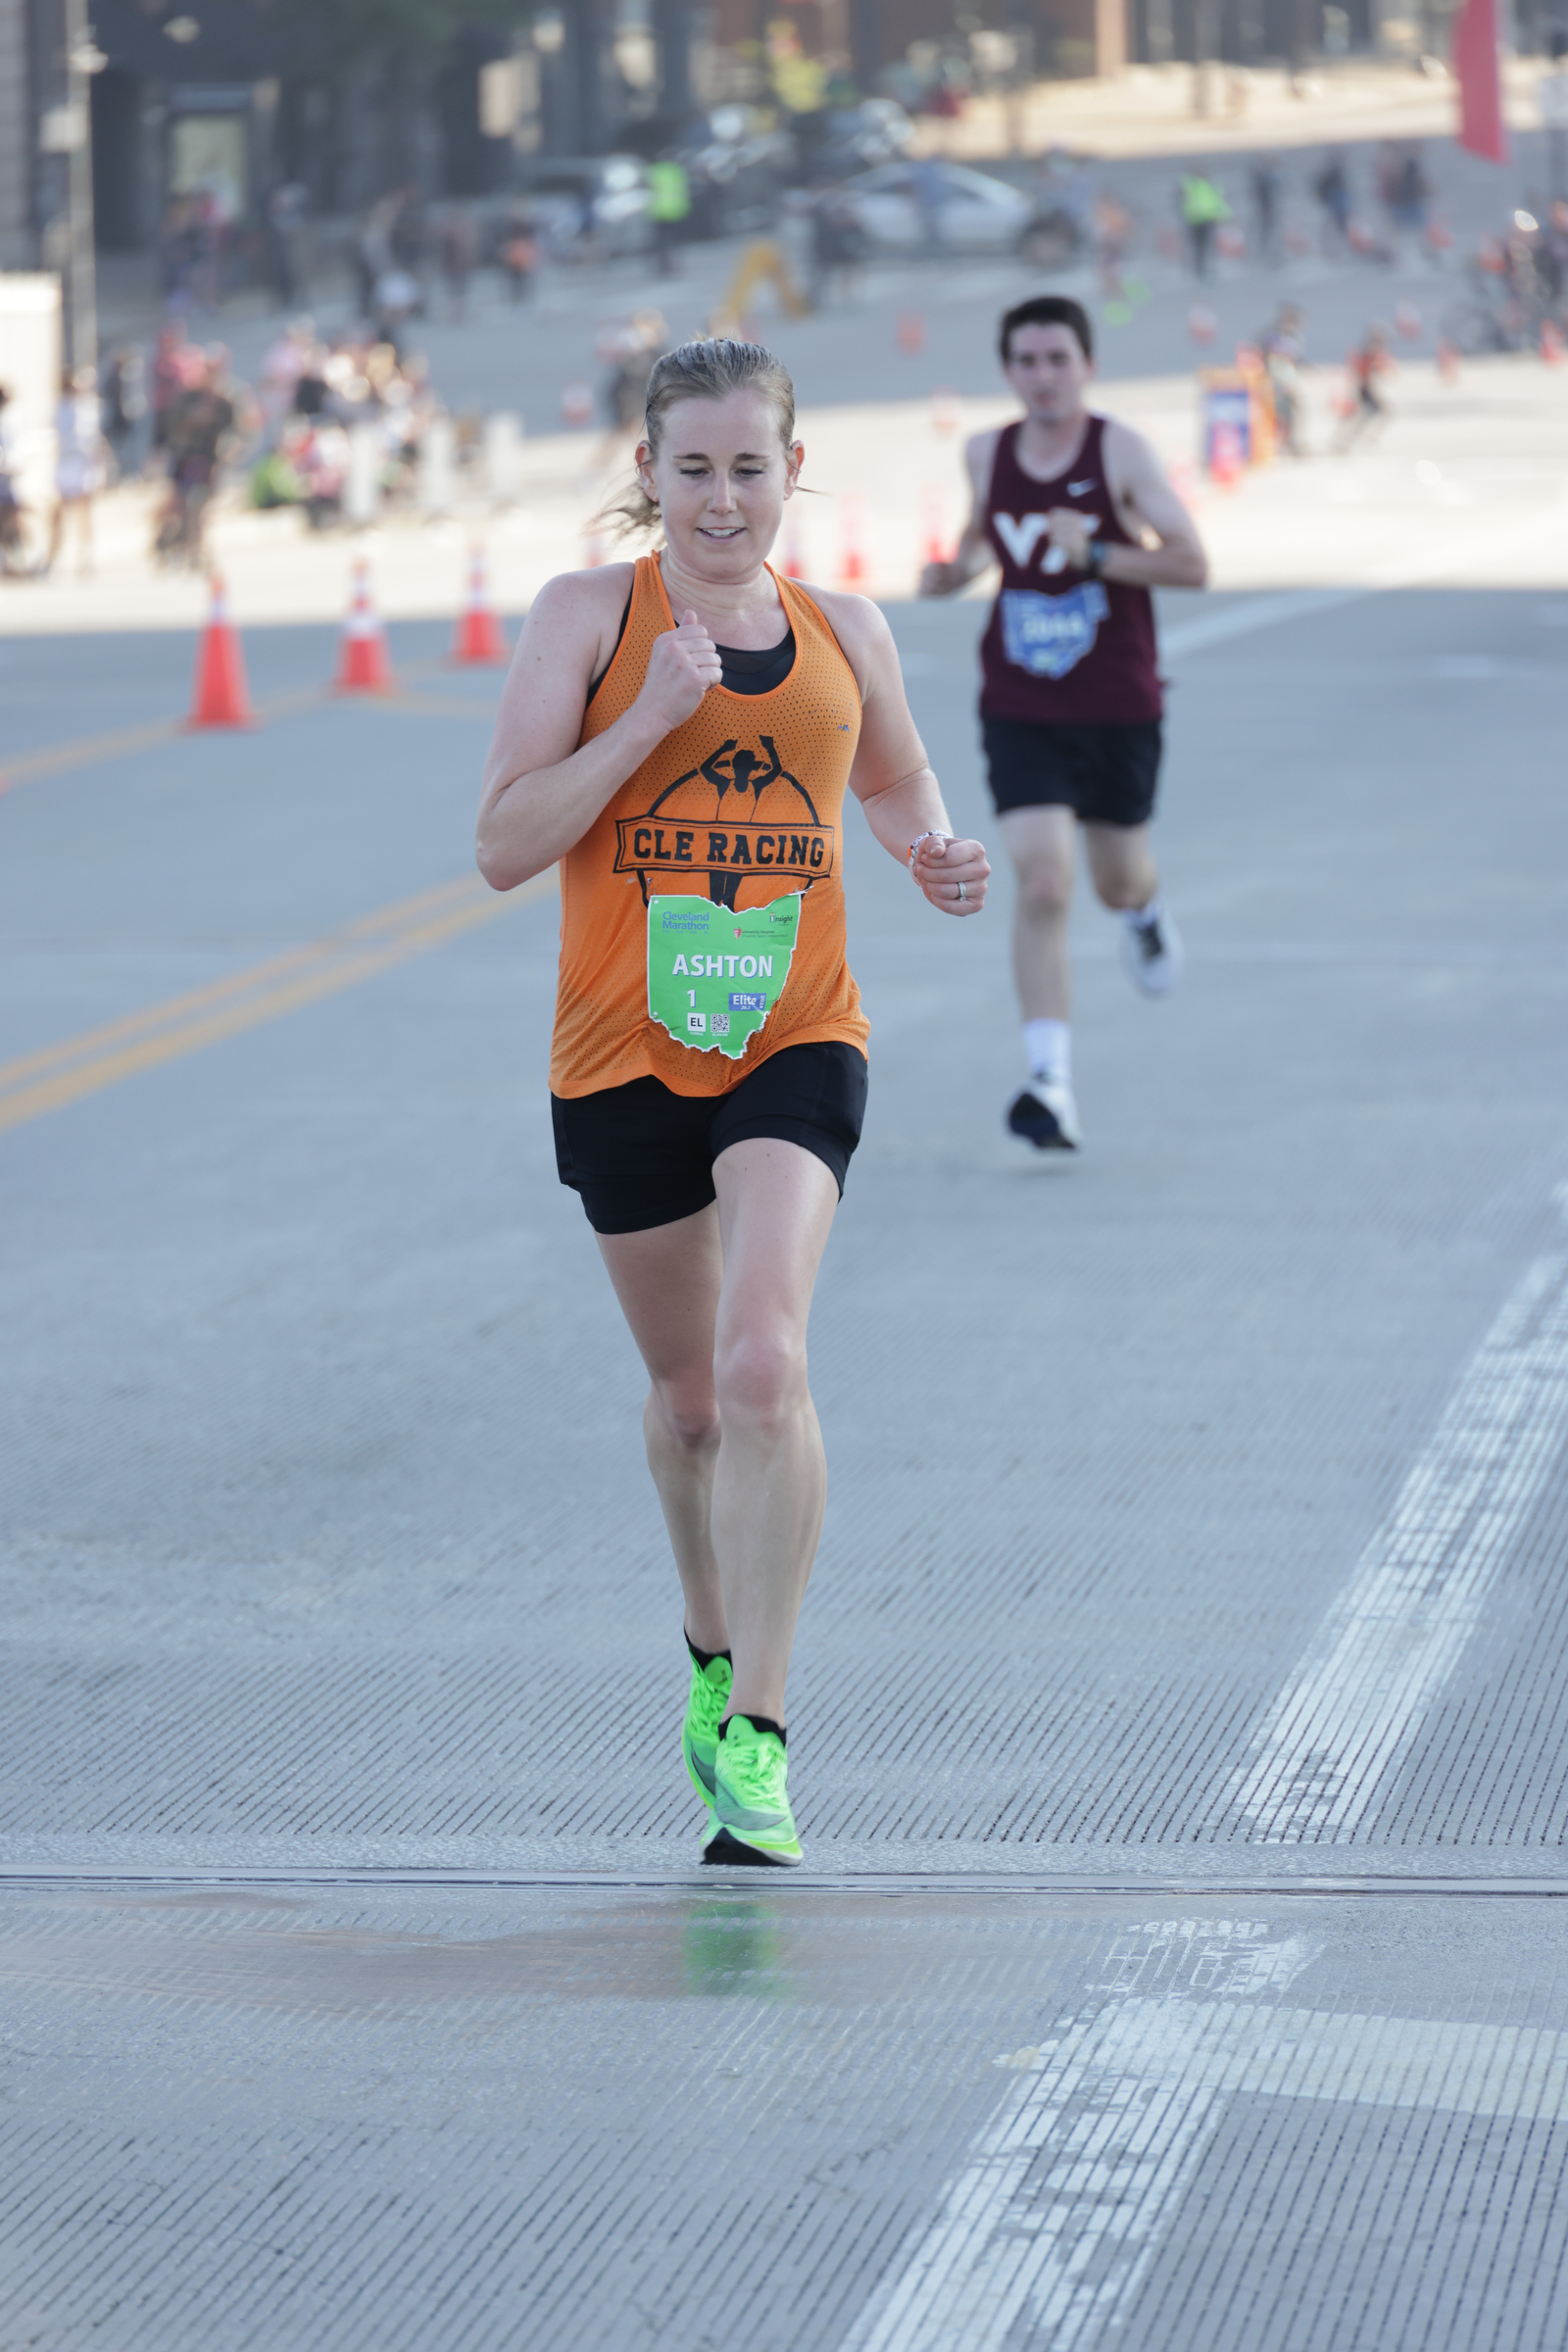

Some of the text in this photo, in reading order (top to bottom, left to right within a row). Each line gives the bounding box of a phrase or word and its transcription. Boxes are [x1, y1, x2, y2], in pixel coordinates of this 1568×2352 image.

[633, 828, 825, 867] CLE RACING
[662, 910, 710, 921] Cleveland
[769, 912, 793, 923] Insight
[662, 920, 710, 930] Marathon
[672, 954, 773, 978] ASHTON
[687, 989, 697, 1007] 1
[733, 995, 757, 1005] Elite
[690, 1017, 704, 1027] EL
